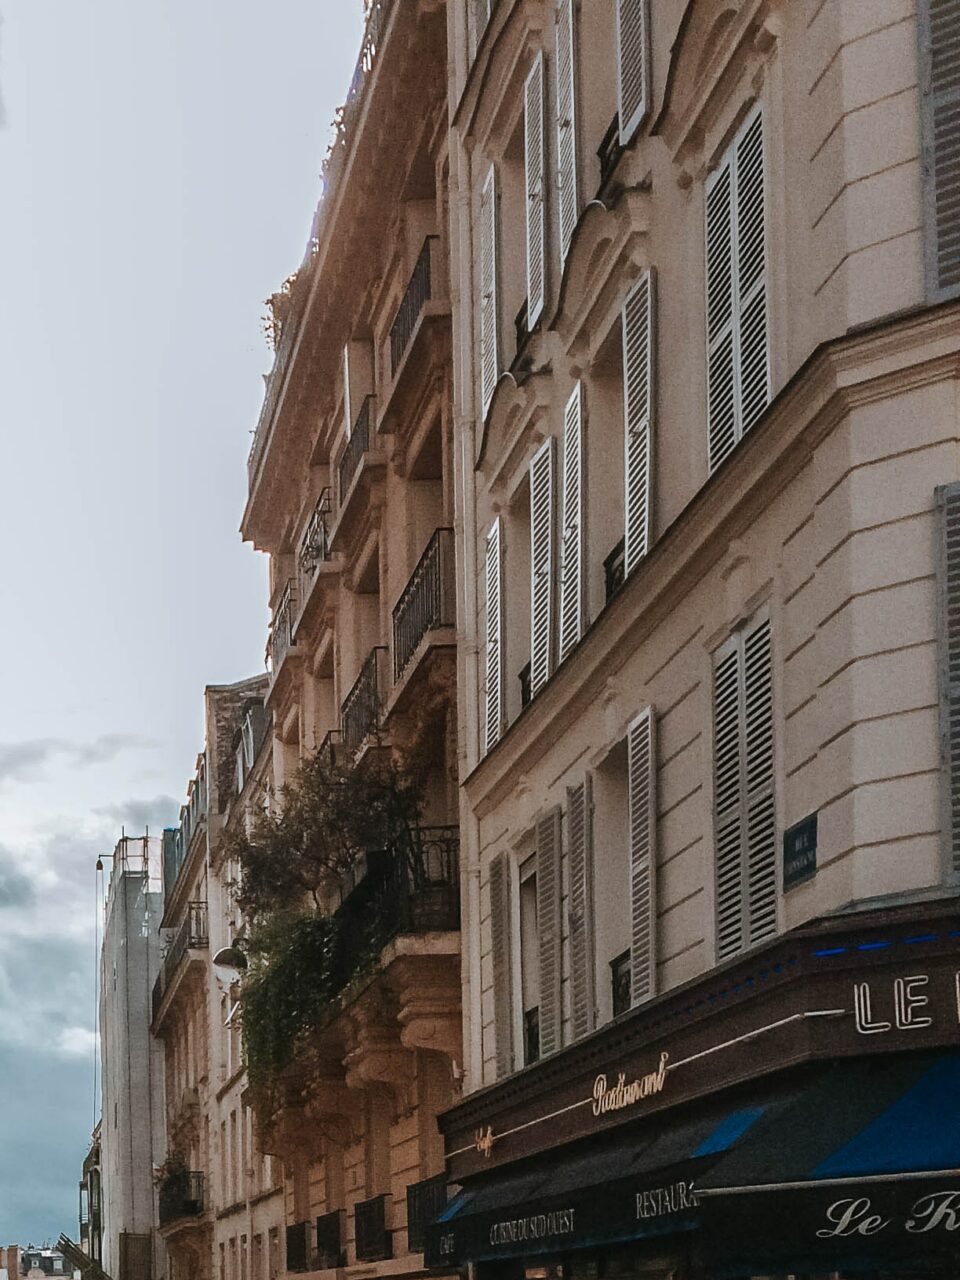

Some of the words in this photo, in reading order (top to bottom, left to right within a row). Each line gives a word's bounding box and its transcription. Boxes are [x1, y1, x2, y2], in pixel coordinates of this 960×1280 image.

[854, 975, 932, 1034] LE
[547, 1208, 576, 1236] OUEST
[816, 1197, 893, 1238] Le
